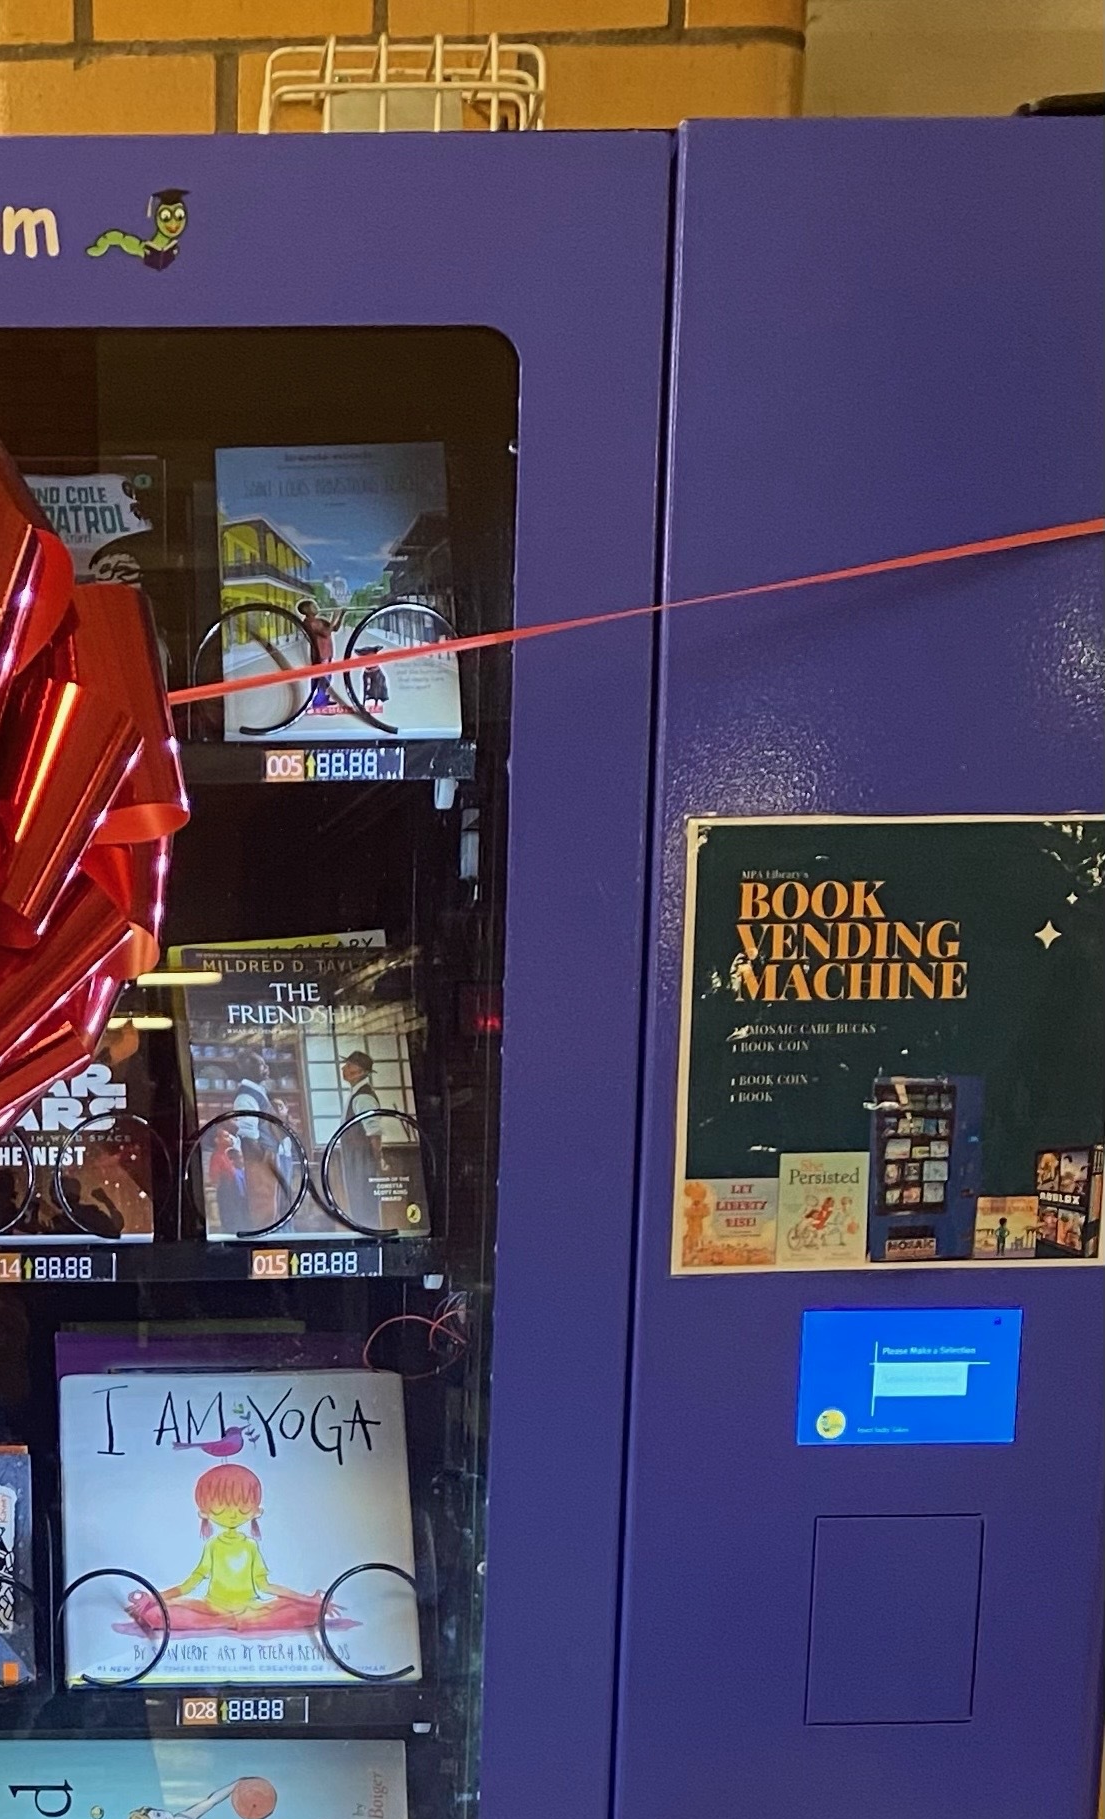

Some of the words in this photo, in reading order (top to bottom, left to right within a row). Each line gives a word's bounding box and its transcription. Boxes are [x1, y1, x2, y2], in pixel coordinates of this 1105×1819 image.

[267, 754, 303, 777] 005
[316, 751, 378, 776] 88.88
[739, 880, 887, 920] BOOK
[736, 920, 962, 961] VENDING
[269, 983, 321, 1002] THE
[734, 962, 969, 1001] MACHINE
[228, 1004, 367, 1025] FRIENDSHIP
[748, 1024, 797, 1035] MOSAIC
[799, 1023, 832, 1035] CARE
[836, 1023, 877, 1034] BUCKS
[740, 1041, 775, 1053] BOOK
[778, 1040, 810, 1051] COIN
[48, 1064, 127, 1098] AR
[739, 1075, 774, 1086] BOOK
[777, 1074, 808, 1085] COIN
[738, 1091, 773, 1103] BOOK
[15, 1097, 127, 1131] ARS
[32, 1147, 87, 1167] NEST
[789, 1167, 860, 1185] Persisted
[34, 1256, 92, 1280] 88.88
[253, 1255, 287, 1275] 015
[299, 1250, 358, 1275] 88.88
[882, 1347, 908, 1356] Please
[910, 1346, 932, 1355] Make
[940, 1346, 976, 1355] Selection
[93, 1385, 128, 1456] I
[153, 1391, 226, 1446] AM
[247, 1387, 381, 1466] YOGA
[184, 1702, 217, 1720] 028
[228, 1699, 284, 1721] 88.88
[370, 1771, 390, 1819] Boiger
[354, 1802, 367, 1819] by
